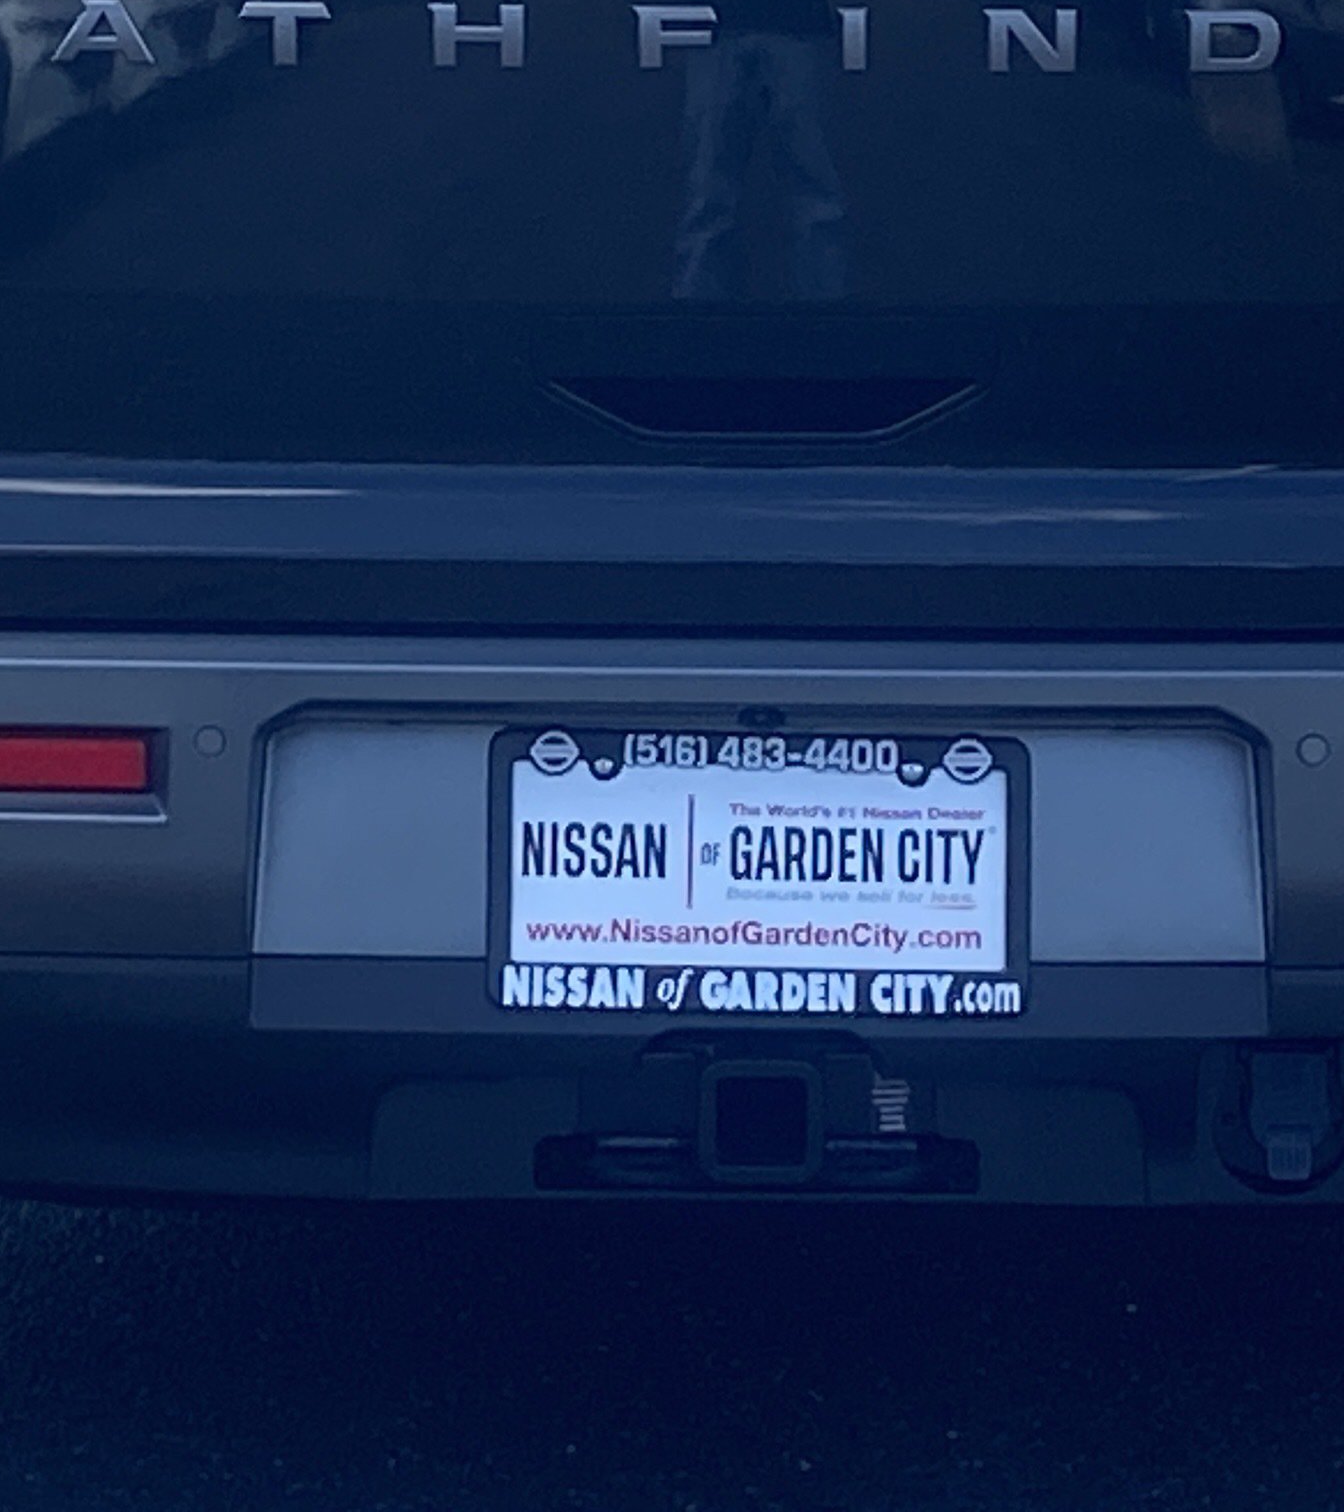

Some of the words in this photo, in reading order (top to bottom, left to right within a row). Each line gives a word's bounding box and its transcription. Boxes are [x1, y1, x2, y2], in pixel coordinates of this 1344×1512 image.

[624, 733, 706, 768] (516)
[717, 736, 899, 772] 483-4400
[729, 802, 761, 817] The
[766, 803, 832, 819] World's
[862, 807, 923, 820] Nissan
[927, 807, 987, 821] Dealer
[522, 821, 667, 879] NISSAN
[700, 842, 721, 866] OF
[729, 824, 884, 883] GARDEN
[897, 827, 986, 885] CITY
[525, 918, 983, 954] www.NissanofGardenCity.com
[502, 964, 647, 1010] NISSAN
[657, 966, 694, 1011] of
[700, 969, 856, 1013] GARDEN
[870, 973, 1022, 1015] CITY.com
